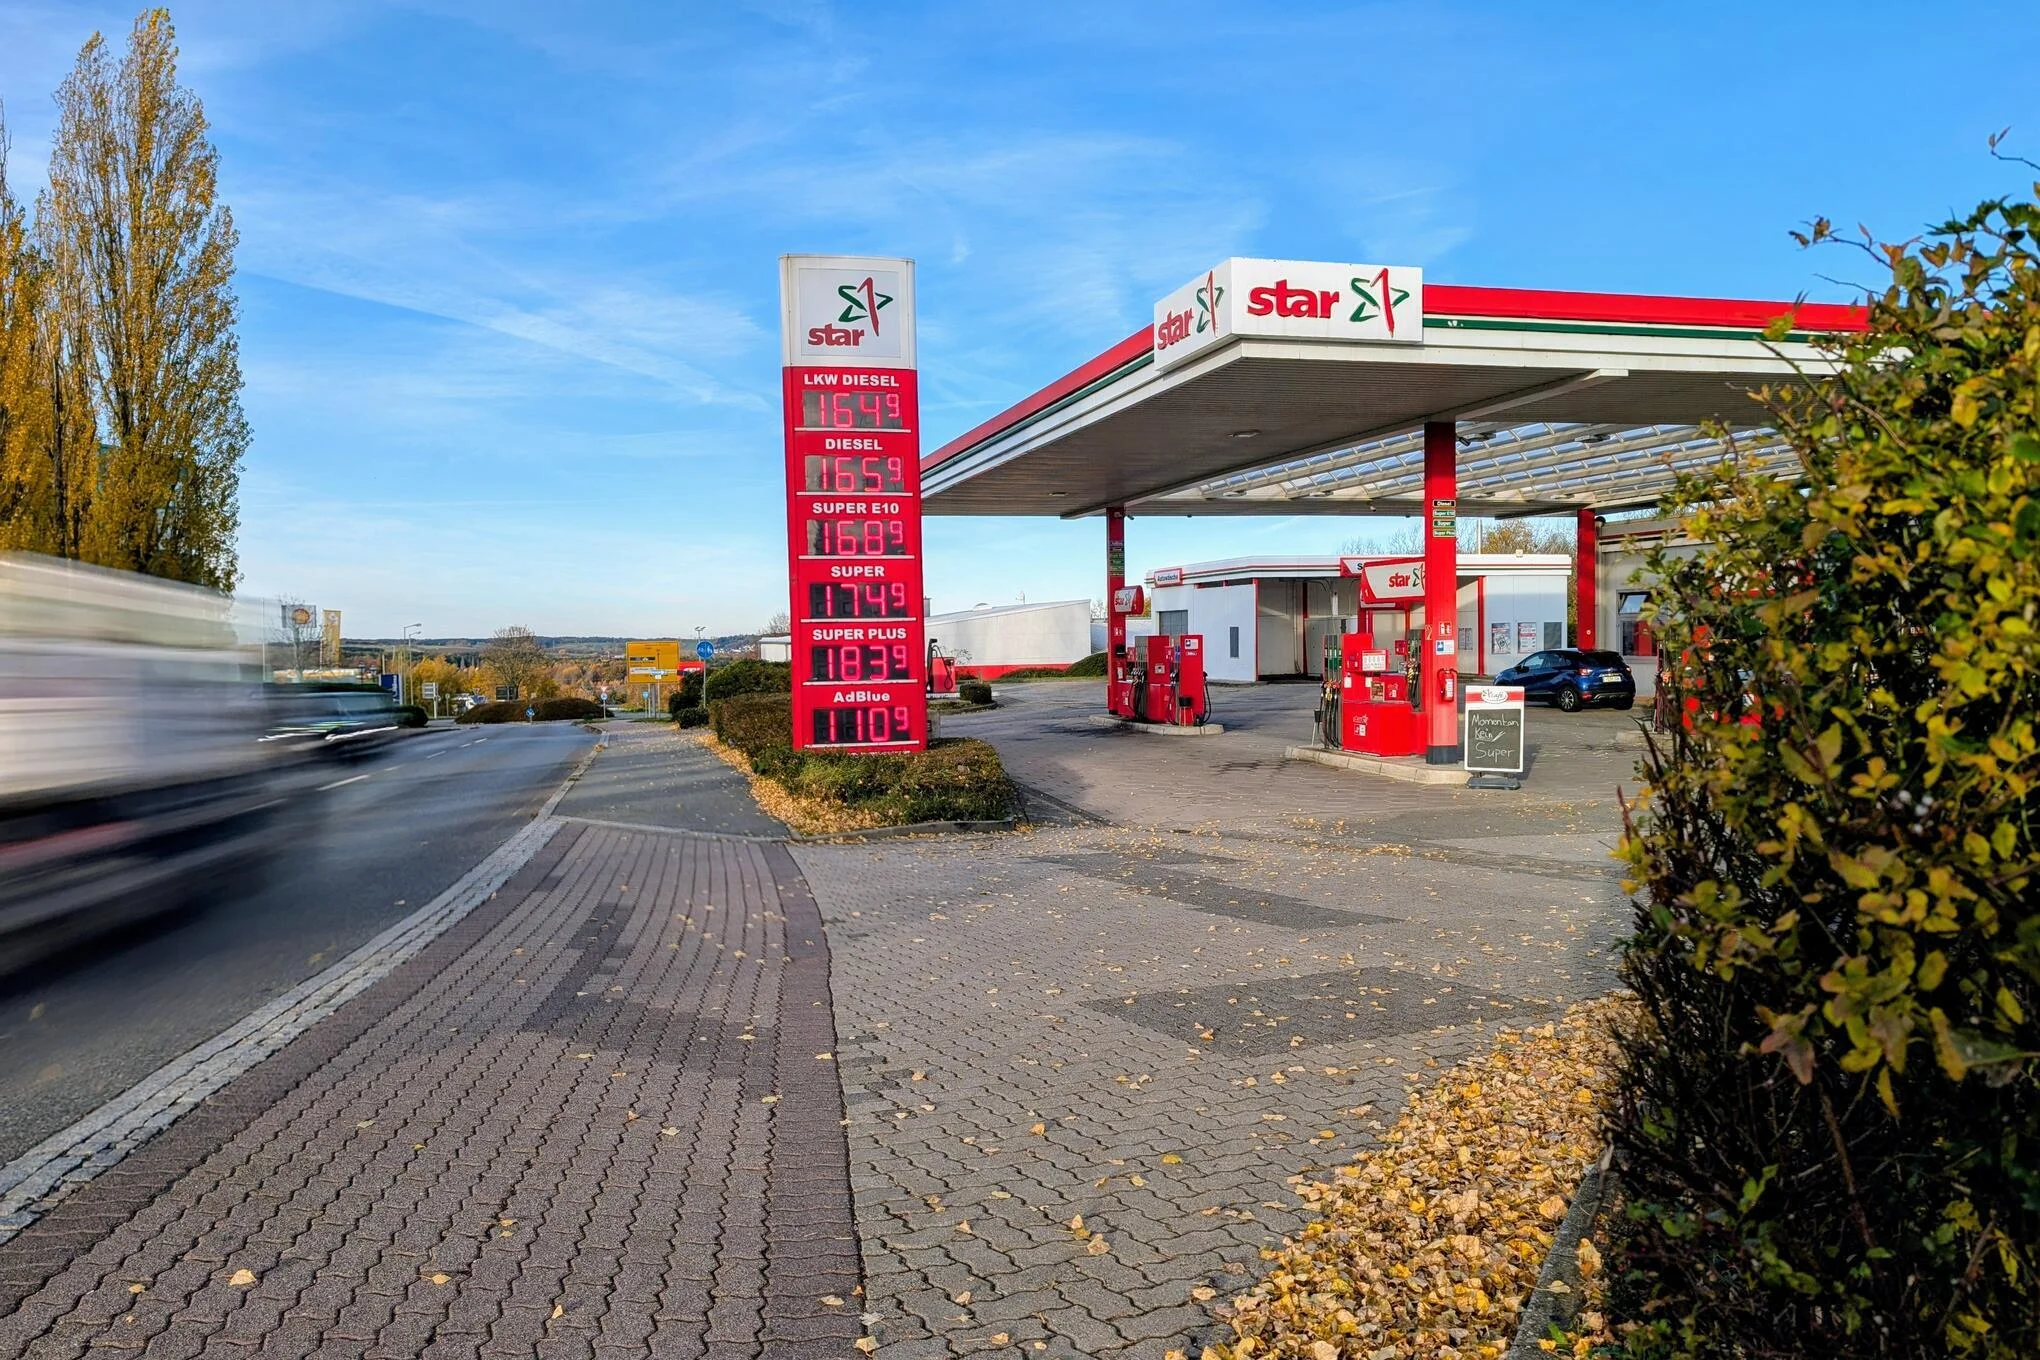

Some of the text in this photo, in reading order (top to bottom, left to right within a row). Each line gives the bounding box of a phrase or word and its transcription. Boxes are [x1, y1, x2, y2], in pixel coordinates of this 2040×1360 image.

[1248, 279, 1340, 319] star
[807, 323, 865, 347] star
[1157, 308, 1194, 350] star
[804, 374, 899, 387] LKW DIESEL
[825, 438, 883, 451] DIESEL
[812, 502, 899, 514] SUPER E10
[830, 566, 885, 578] SUPER
[1388, 572, 1411, 588] star
[812, 628, 907, 641] SUPER PLUS
[833, 691, 890, 703] AdBlue
[1475, 742, 1515, 763] Super
